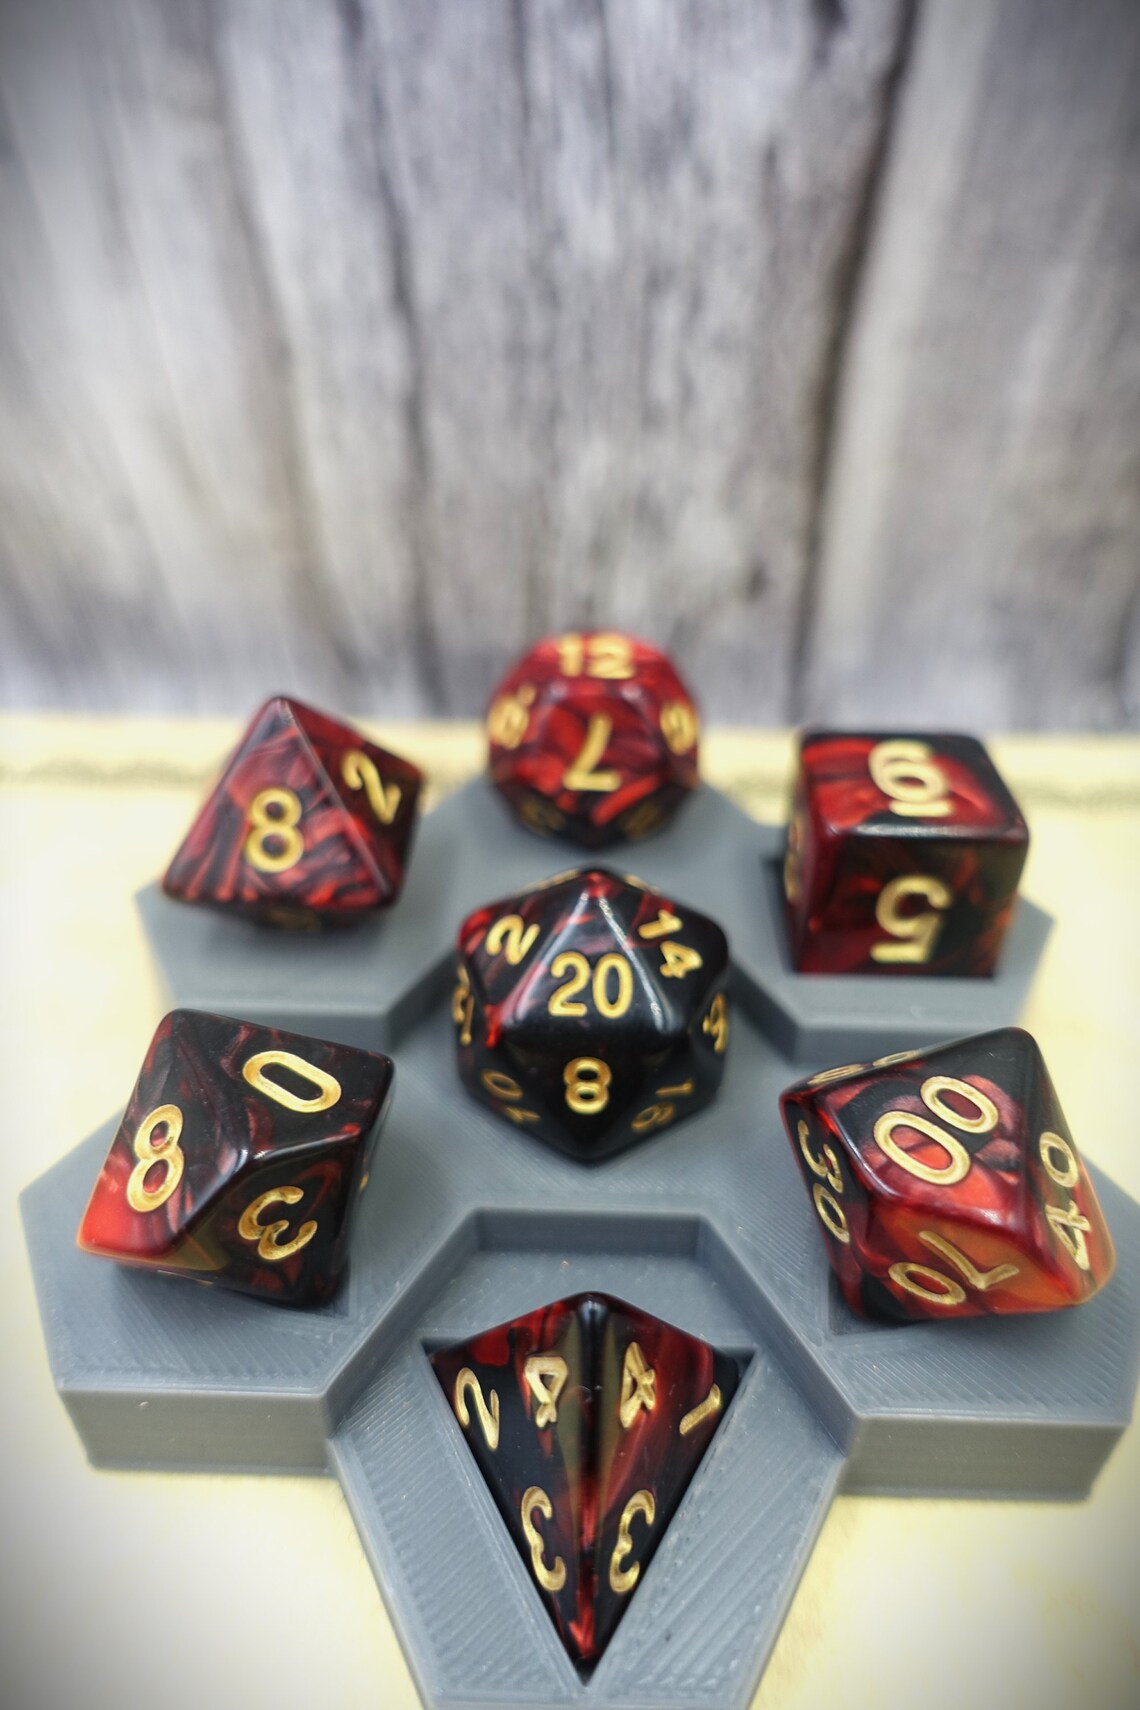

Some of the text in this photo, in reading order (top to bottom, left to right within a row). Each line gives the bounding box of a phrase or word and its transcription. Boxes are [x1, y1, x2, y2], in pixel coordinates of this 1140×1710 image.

[557, 633, 636, 680] 12
[341, 751, 401, 824] 2
[563, 713, 621, 791] 7
[245, 787, 304, 873] 8
[486, 915, 540, 965] 2
[639, 909, 703, 979] 14
[870, 874, 951, 964] 5
[548, 951, 634, 1018] 20
[242, 1050, 342, 1113] 0
[564, 1056, 612, 1114] 8
[126, 1104, 184, 1213] 8
[873, 1076, 999, 1185] 00
[798, 1120, 850, 1243] 30
[1039, 1131, 1091, 1271] 40
[238, 1186, 318, 1262] 3
[888, 1231, 1019, 1305] 70
[455, 1367, 500, 1452] 2
[524, 1355, 568, 1429] 4
[619, 1341, 656, 1430] 4
[679, 1383, 722, 1436] 1
[521, 1486, 566, 1592] 3
[609, 1490, 656, 1593] 3
